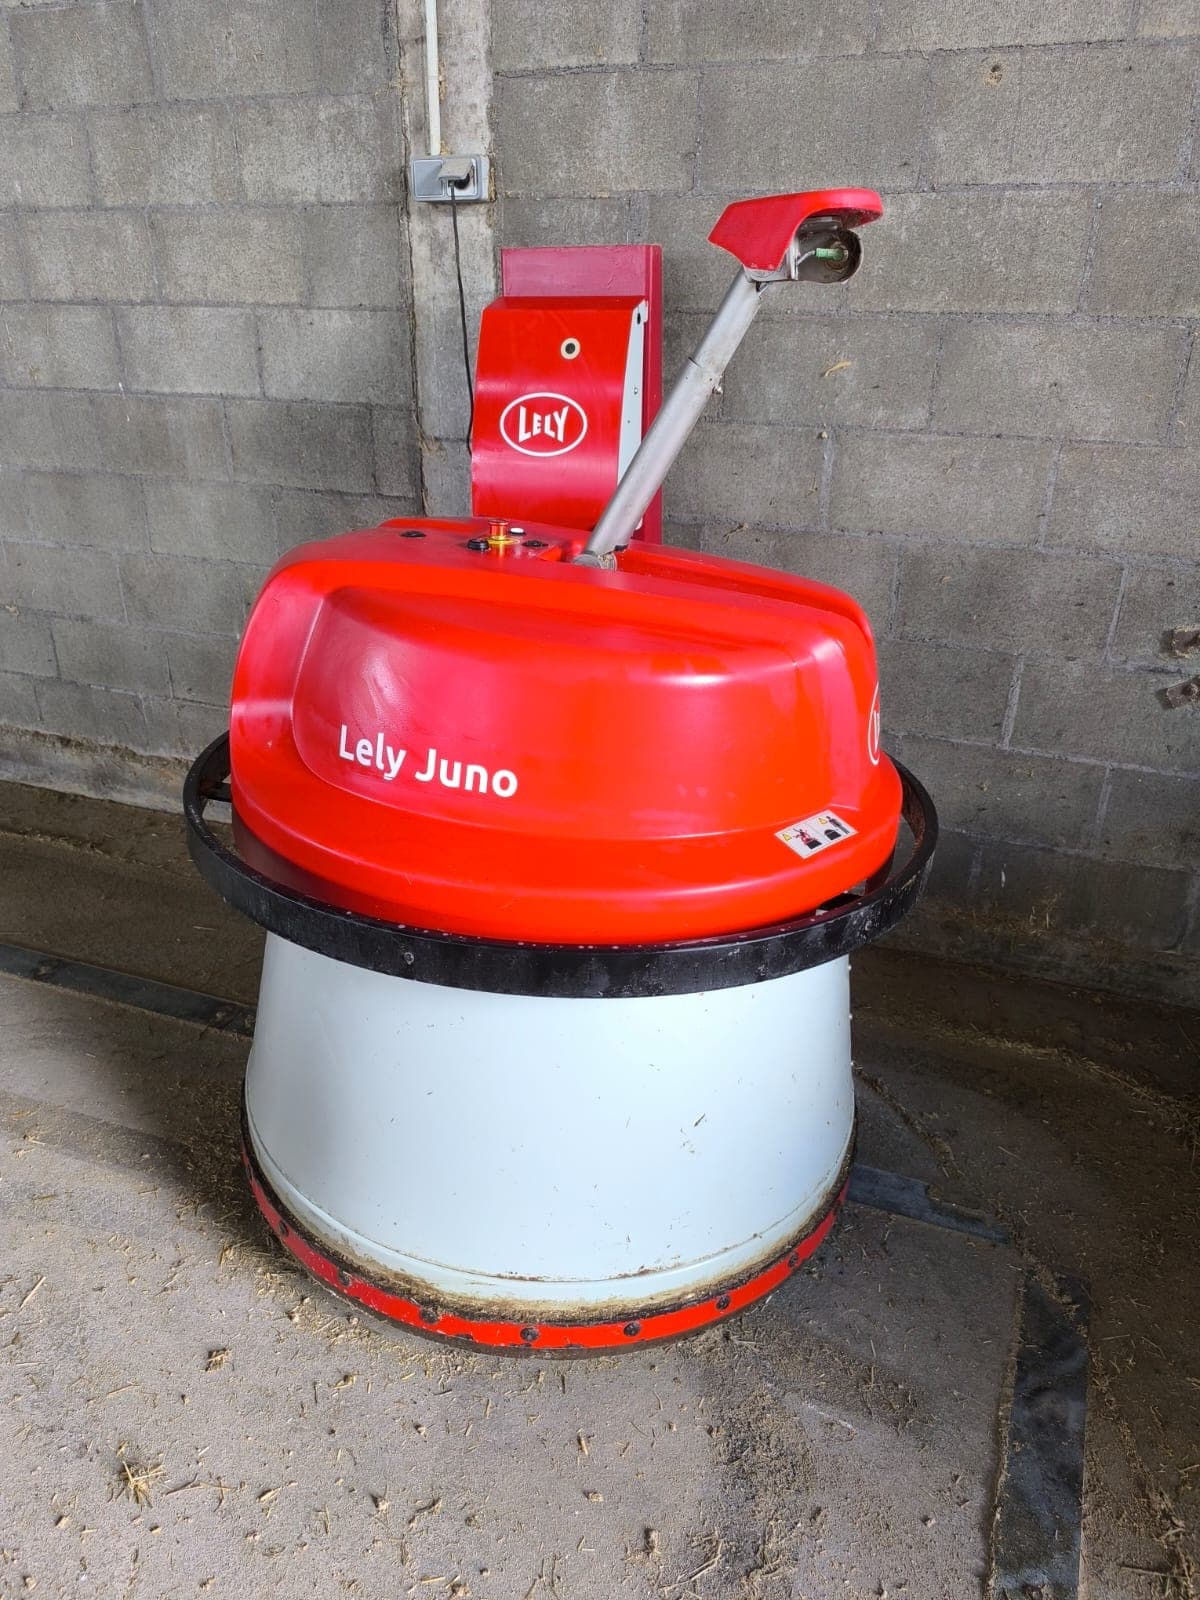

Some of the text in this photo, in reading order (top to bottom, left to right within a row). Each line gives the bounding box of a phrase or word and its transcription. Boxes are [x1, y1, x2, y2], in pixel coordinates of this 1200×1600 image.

[518, 405, 569, 443] LELY
[338, 724, 518, 798] Lely Juno
